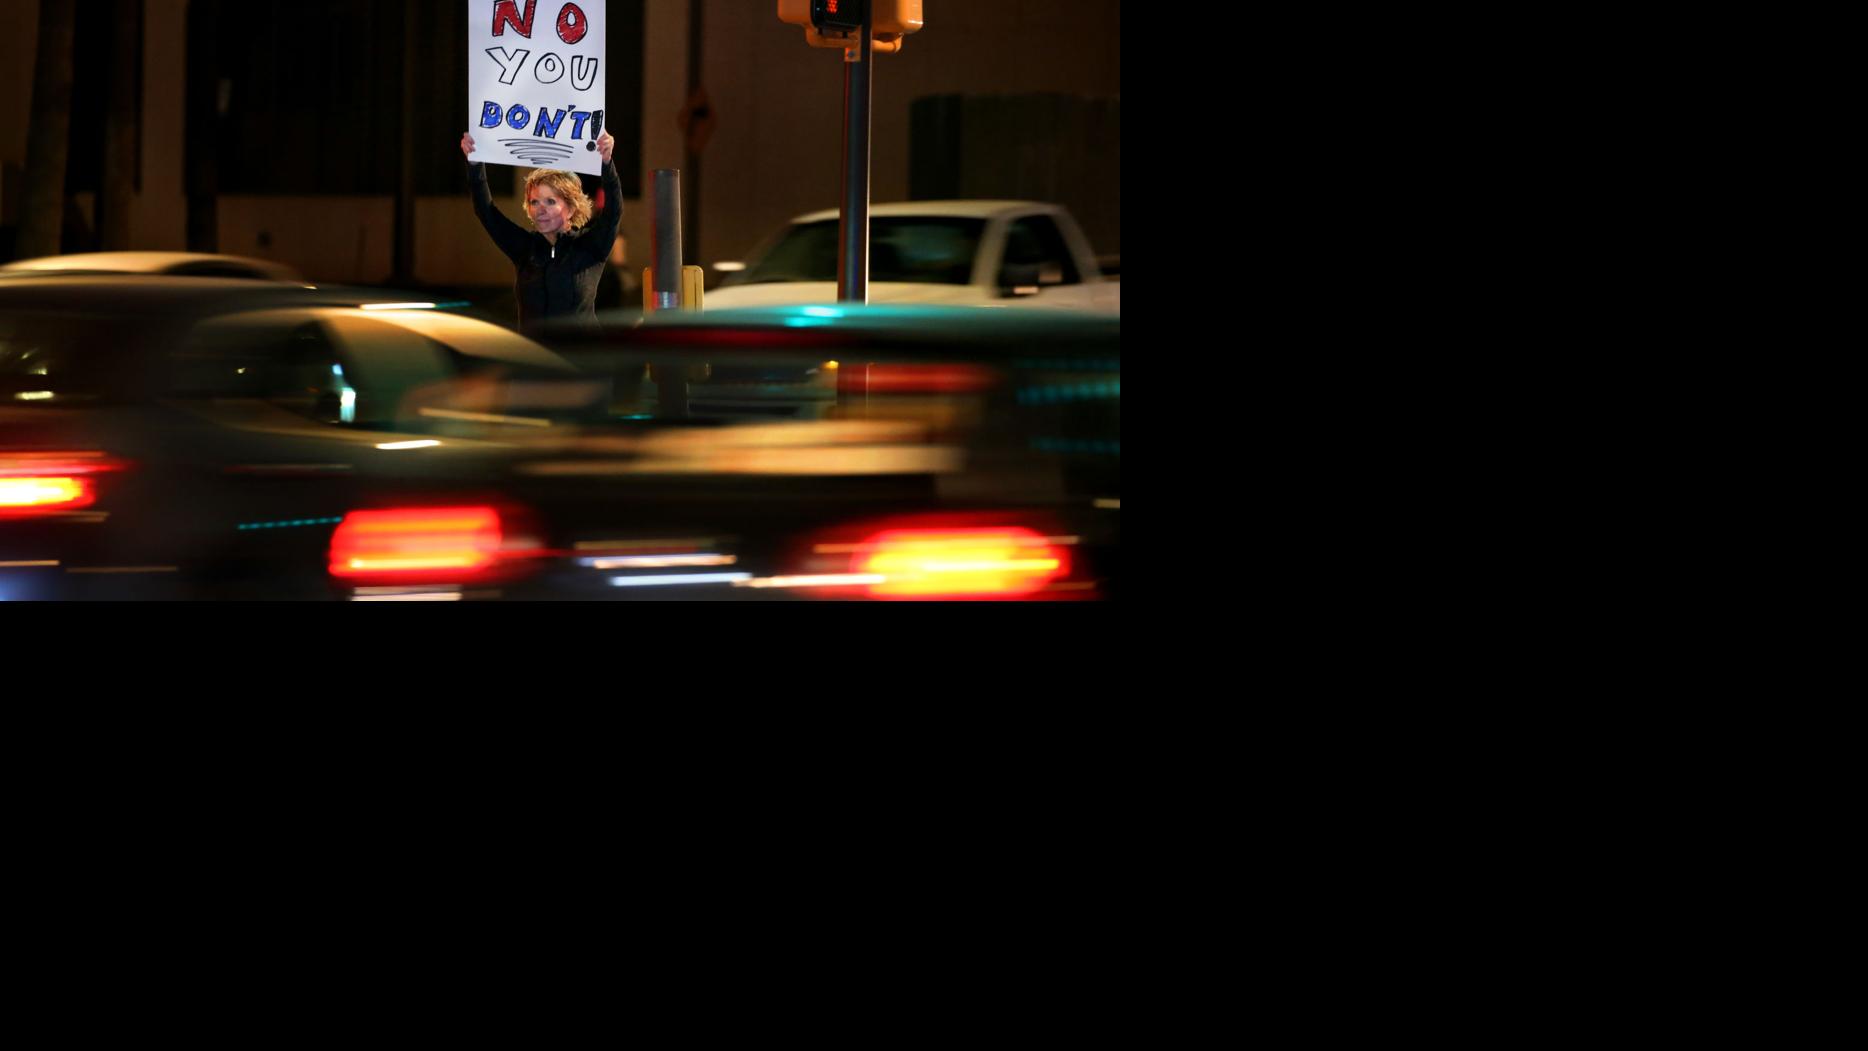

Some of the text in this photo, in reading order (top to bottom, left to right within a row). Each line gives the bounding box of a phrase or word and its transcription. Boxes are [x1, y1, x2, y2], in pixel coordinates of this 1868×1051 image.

[492, 0, 588, 45] NO
[485, 46, 598, 91] YOU
[479, 101, 603, 152] DON'T!
